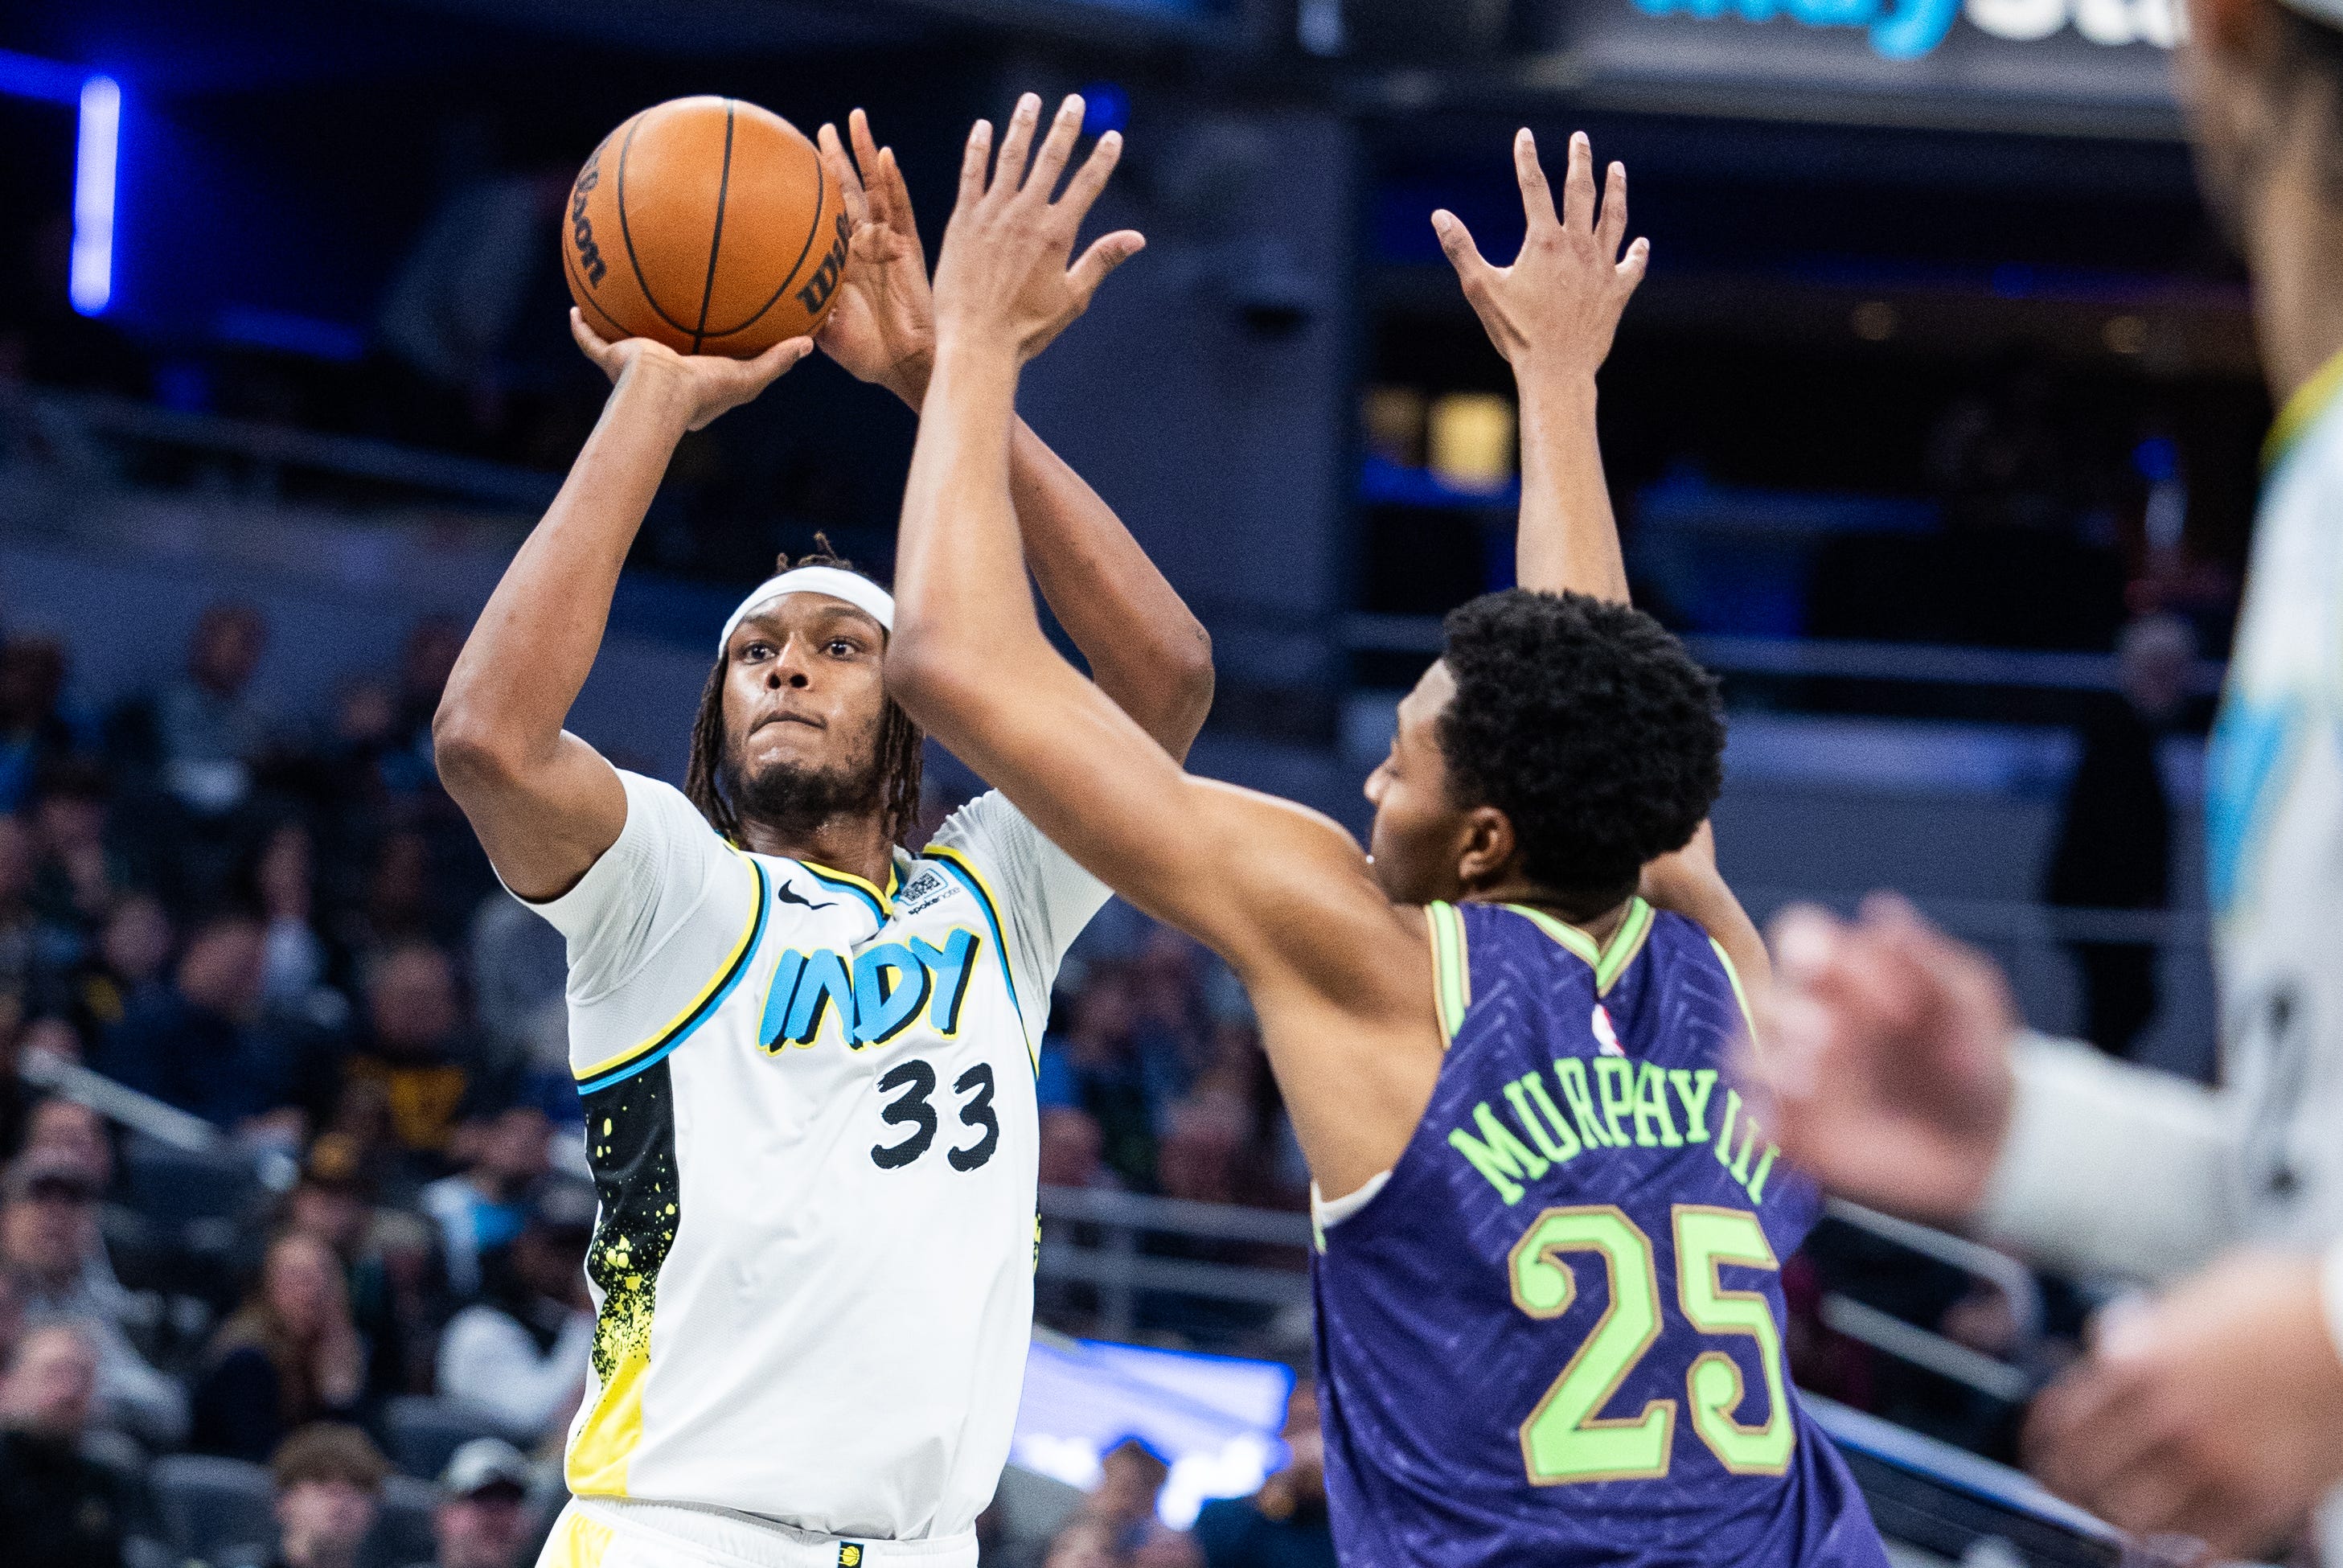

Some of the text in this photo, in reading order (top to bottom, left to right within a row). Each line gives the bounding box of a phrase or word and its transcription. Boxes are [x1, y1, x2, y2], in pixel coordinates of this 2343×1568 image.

[757, 925, 983, 1055] INDY
[871, 1059, 999, 1172] 33
[1449, 1056, 1717, 1206] MURPHY
[1508, 1205, 1796, 1487] 25
